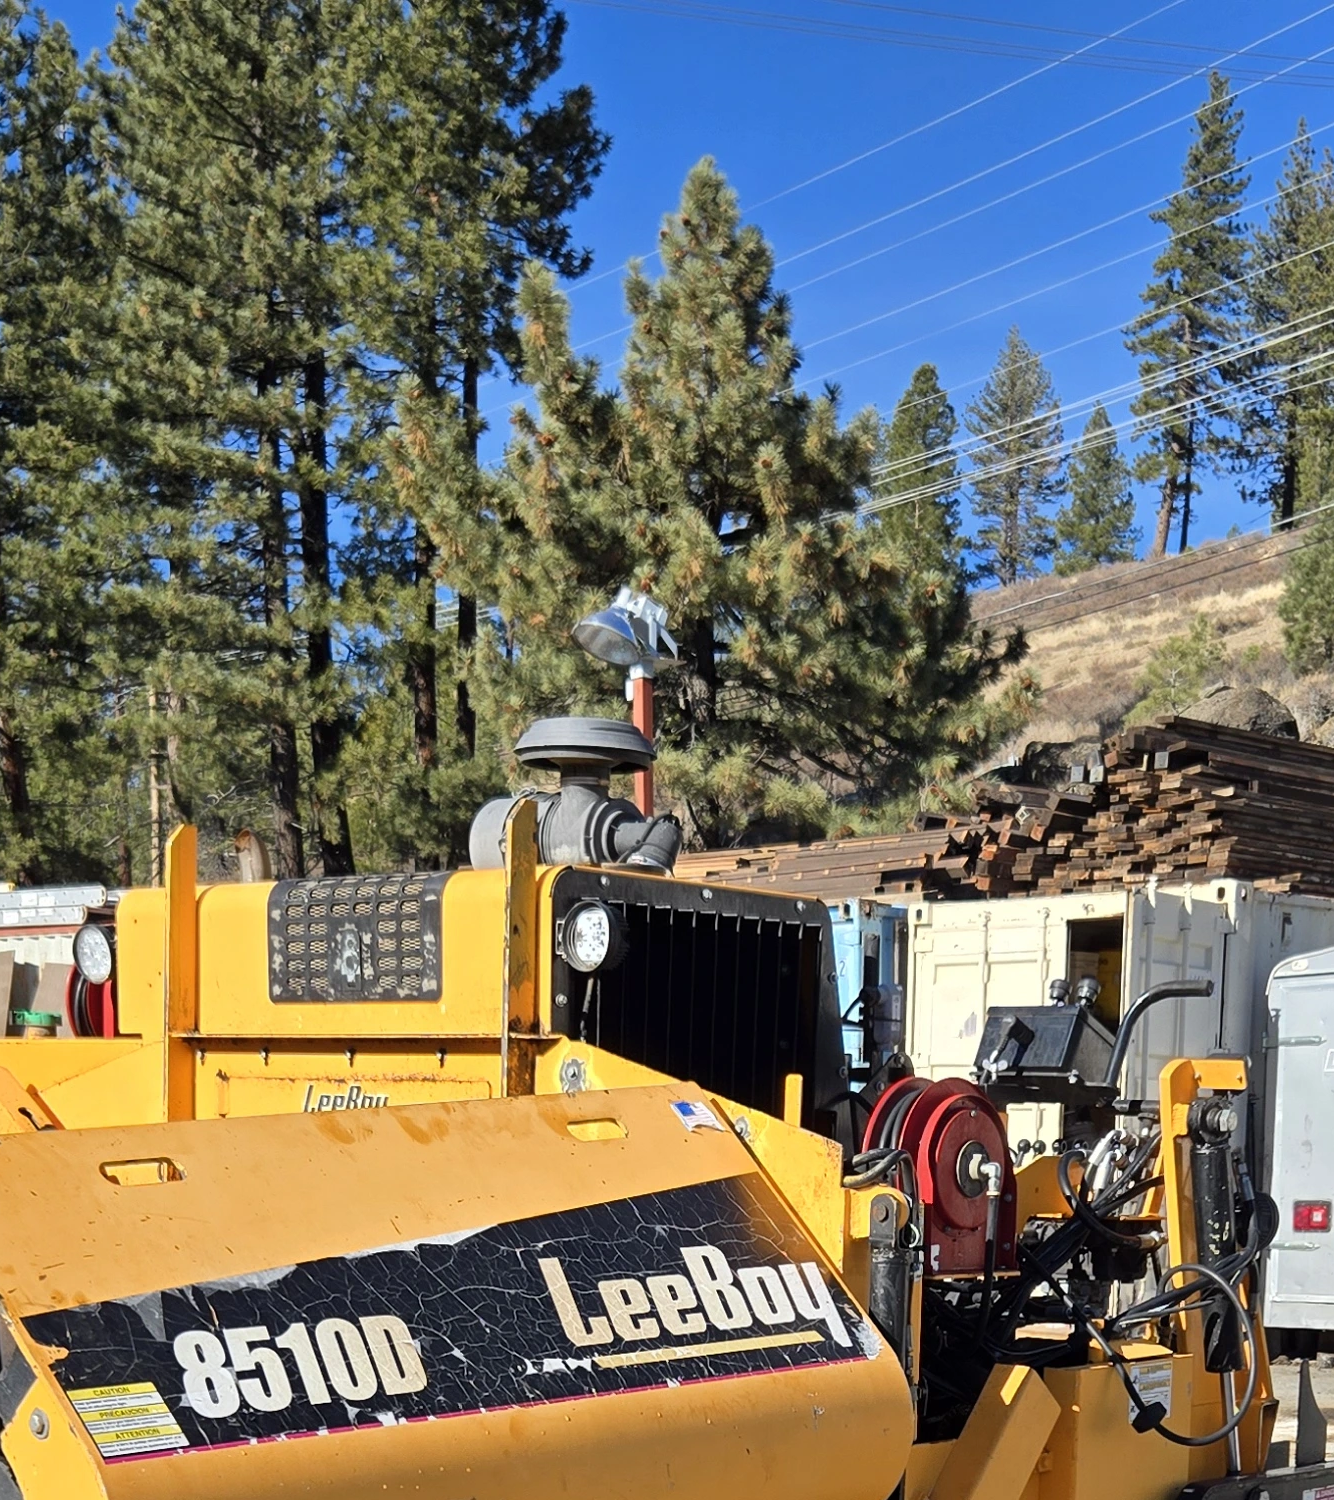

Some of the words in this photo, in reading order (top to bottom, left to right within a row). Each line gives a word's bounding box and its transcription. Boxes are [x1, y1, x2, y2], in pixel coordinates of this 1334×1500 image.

[538, 1245, 852, 1347] LeeBoy
[93, 1387, 130, 1396] CAUTION
[173, 1315, 427, 1418] 8510D
[115, 1429, 160, 1440] ATTENTION
